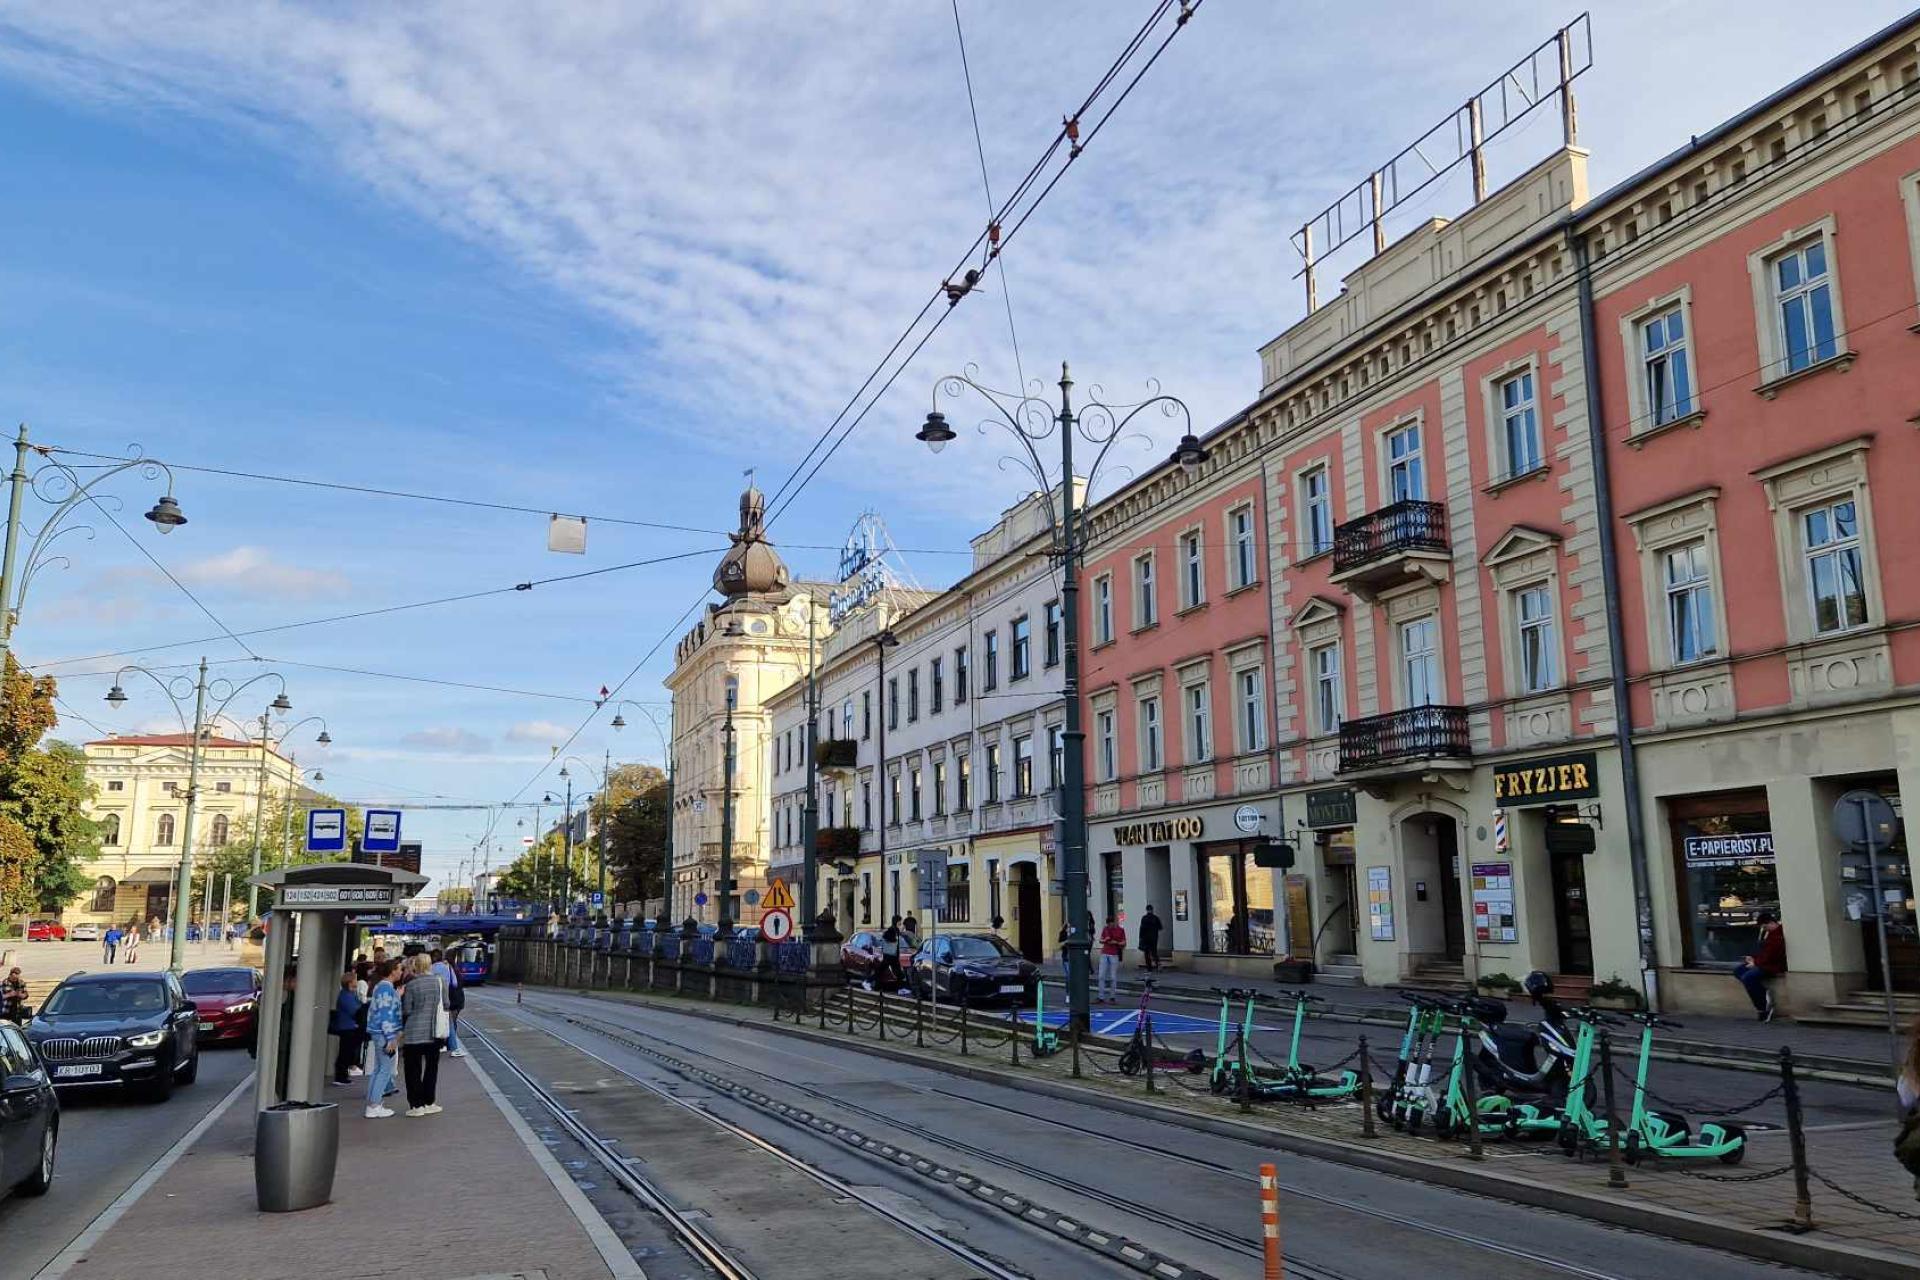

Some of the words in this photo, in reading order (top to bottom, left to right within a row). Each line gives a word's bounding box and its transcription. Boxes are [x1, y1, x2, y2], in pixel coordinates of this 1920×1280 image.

[1495, 763, 1589, 798] FRYZJER
[1149, 816, 1203, 843] TATTOO
[1689, 837, 1775, 856] E-PAPIEROSY.PL
[594, 893, 601, 902] P
